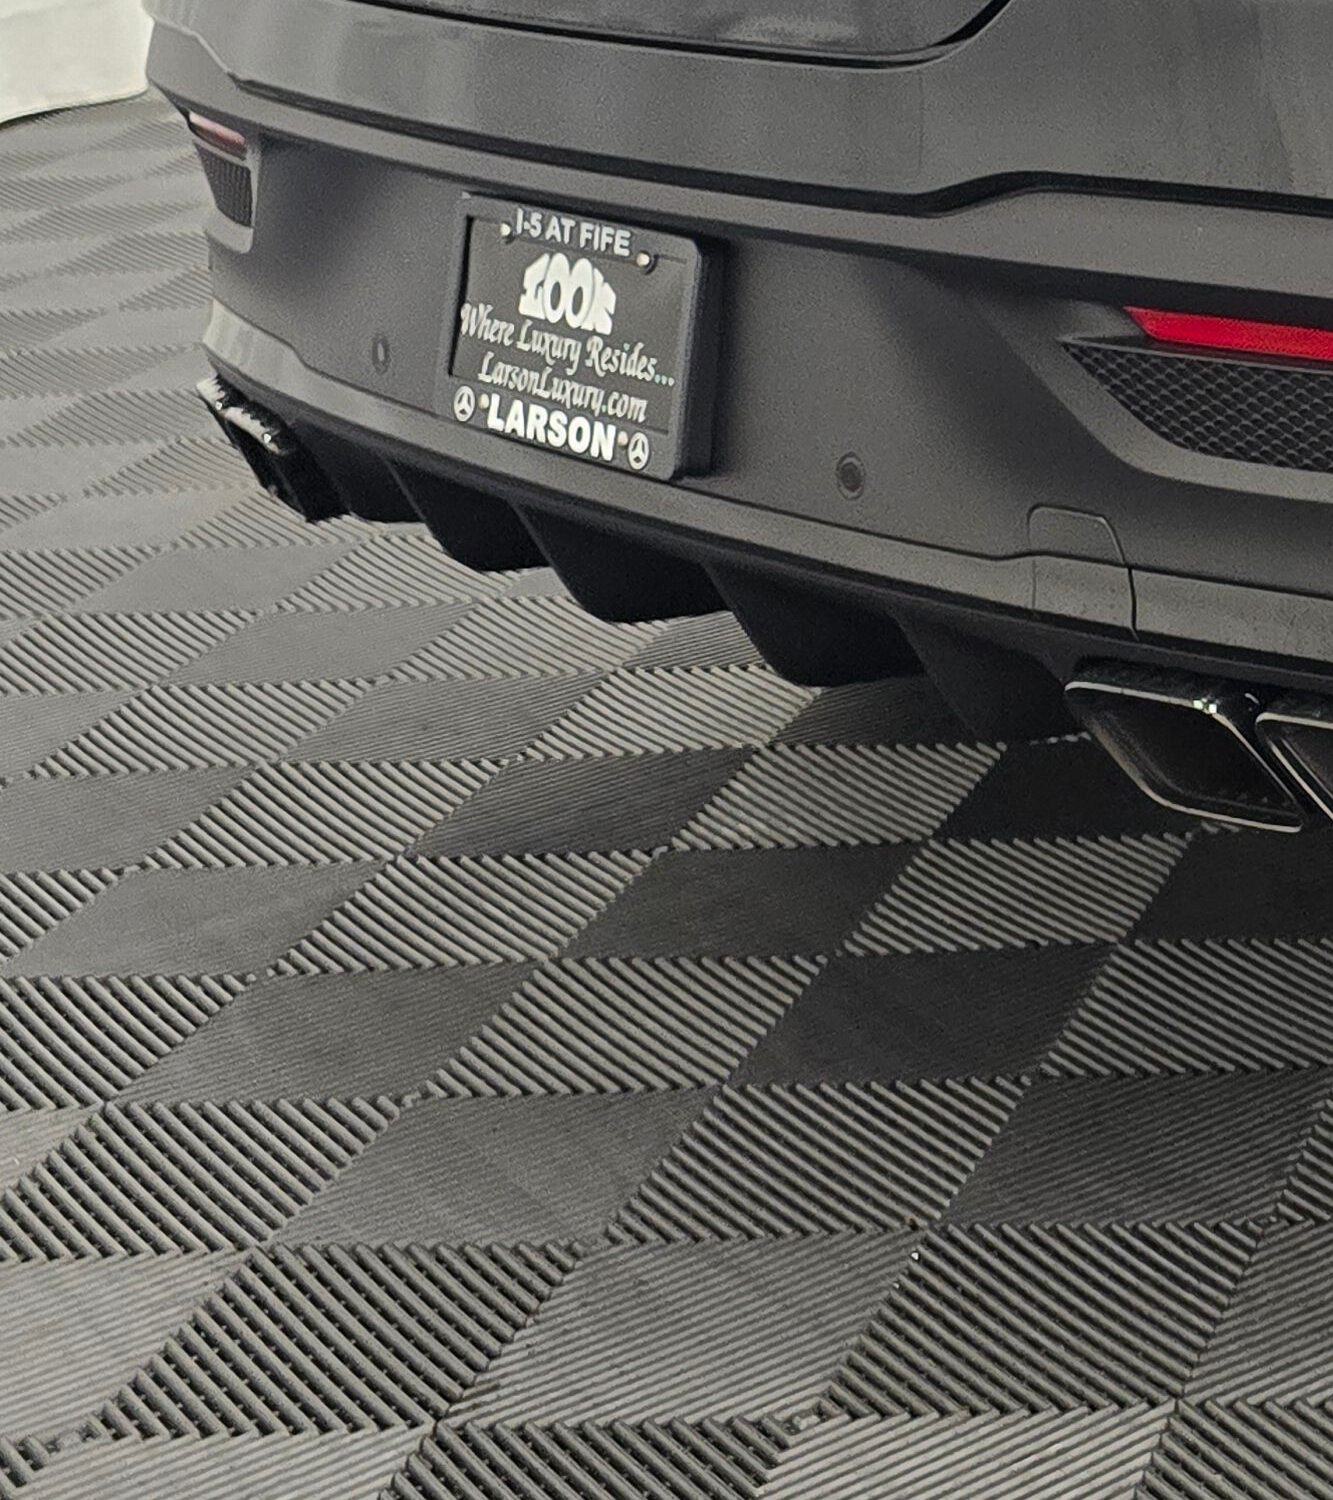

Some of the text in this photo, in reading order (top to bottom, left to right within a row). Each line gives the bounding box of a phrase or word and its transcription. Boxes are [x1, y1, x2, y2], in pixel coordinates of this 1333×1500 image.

[515, 208, 632, 257] I-5 AT FIFE
[460, 302, 675, 386] Where Luxury Resides...
[477, 351, 648, 423] LarsonLuxury.com
[486, 393, 617, 461] LARSON
